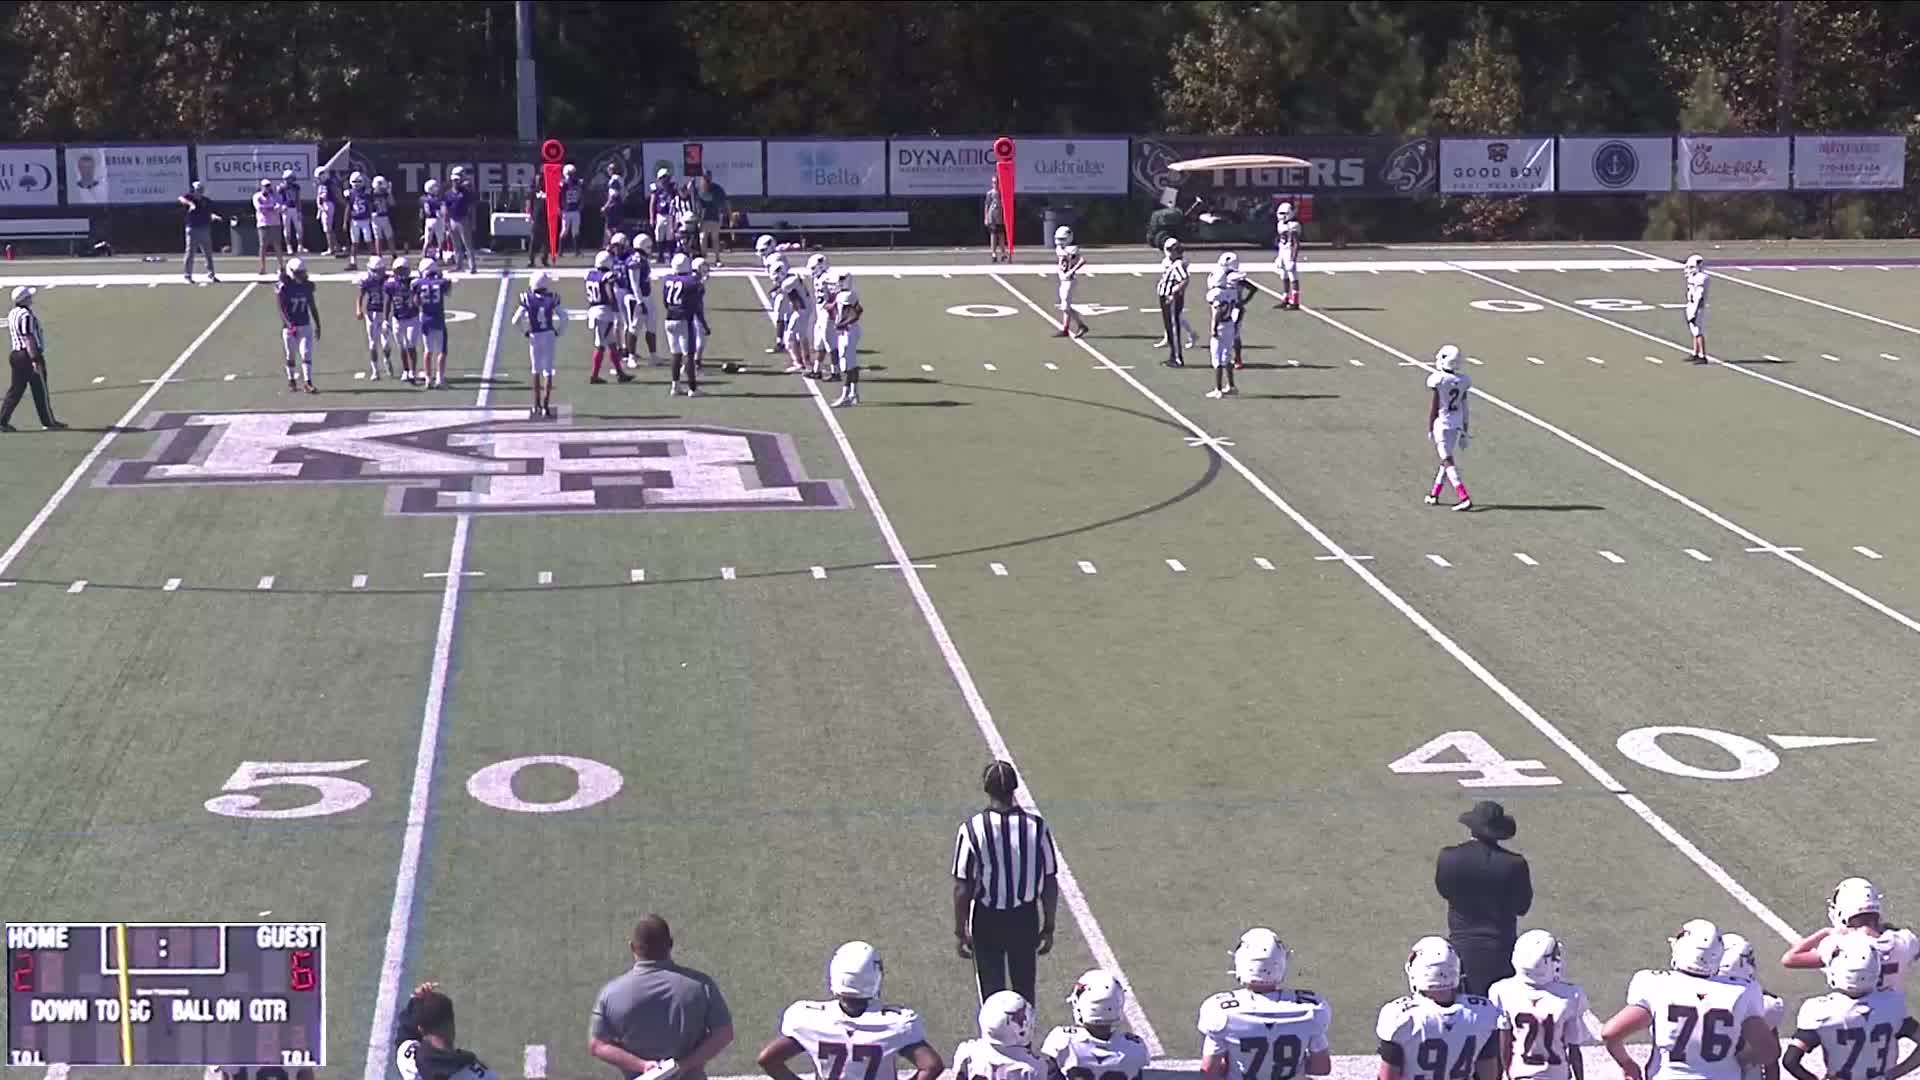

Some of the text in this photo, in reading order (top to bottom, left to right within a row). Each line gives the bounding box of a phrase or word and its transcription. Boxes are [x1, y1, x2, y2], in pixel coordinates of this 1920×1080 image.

[213, 161, 301, 173] SURCHEROS
[899, 149, 998, 165] DYNAMIC
[1454, 167, 1541, 178] GOOD BOY
[815, 167, 861, 185] Bella
[665, 280, 683, 304] 72
[1448, 388, 1460, 411] 2
[1515, 1013, 1562, 1065] 21
[1668, 1004, 1734, 1062] 76
[818, 1041, 883, 1080] 77
[1240, 1034, 1302, 1080] 78
[1414, 1035, 1477, 1080] 94
[1836, 1023, 1893, 1080] 73
